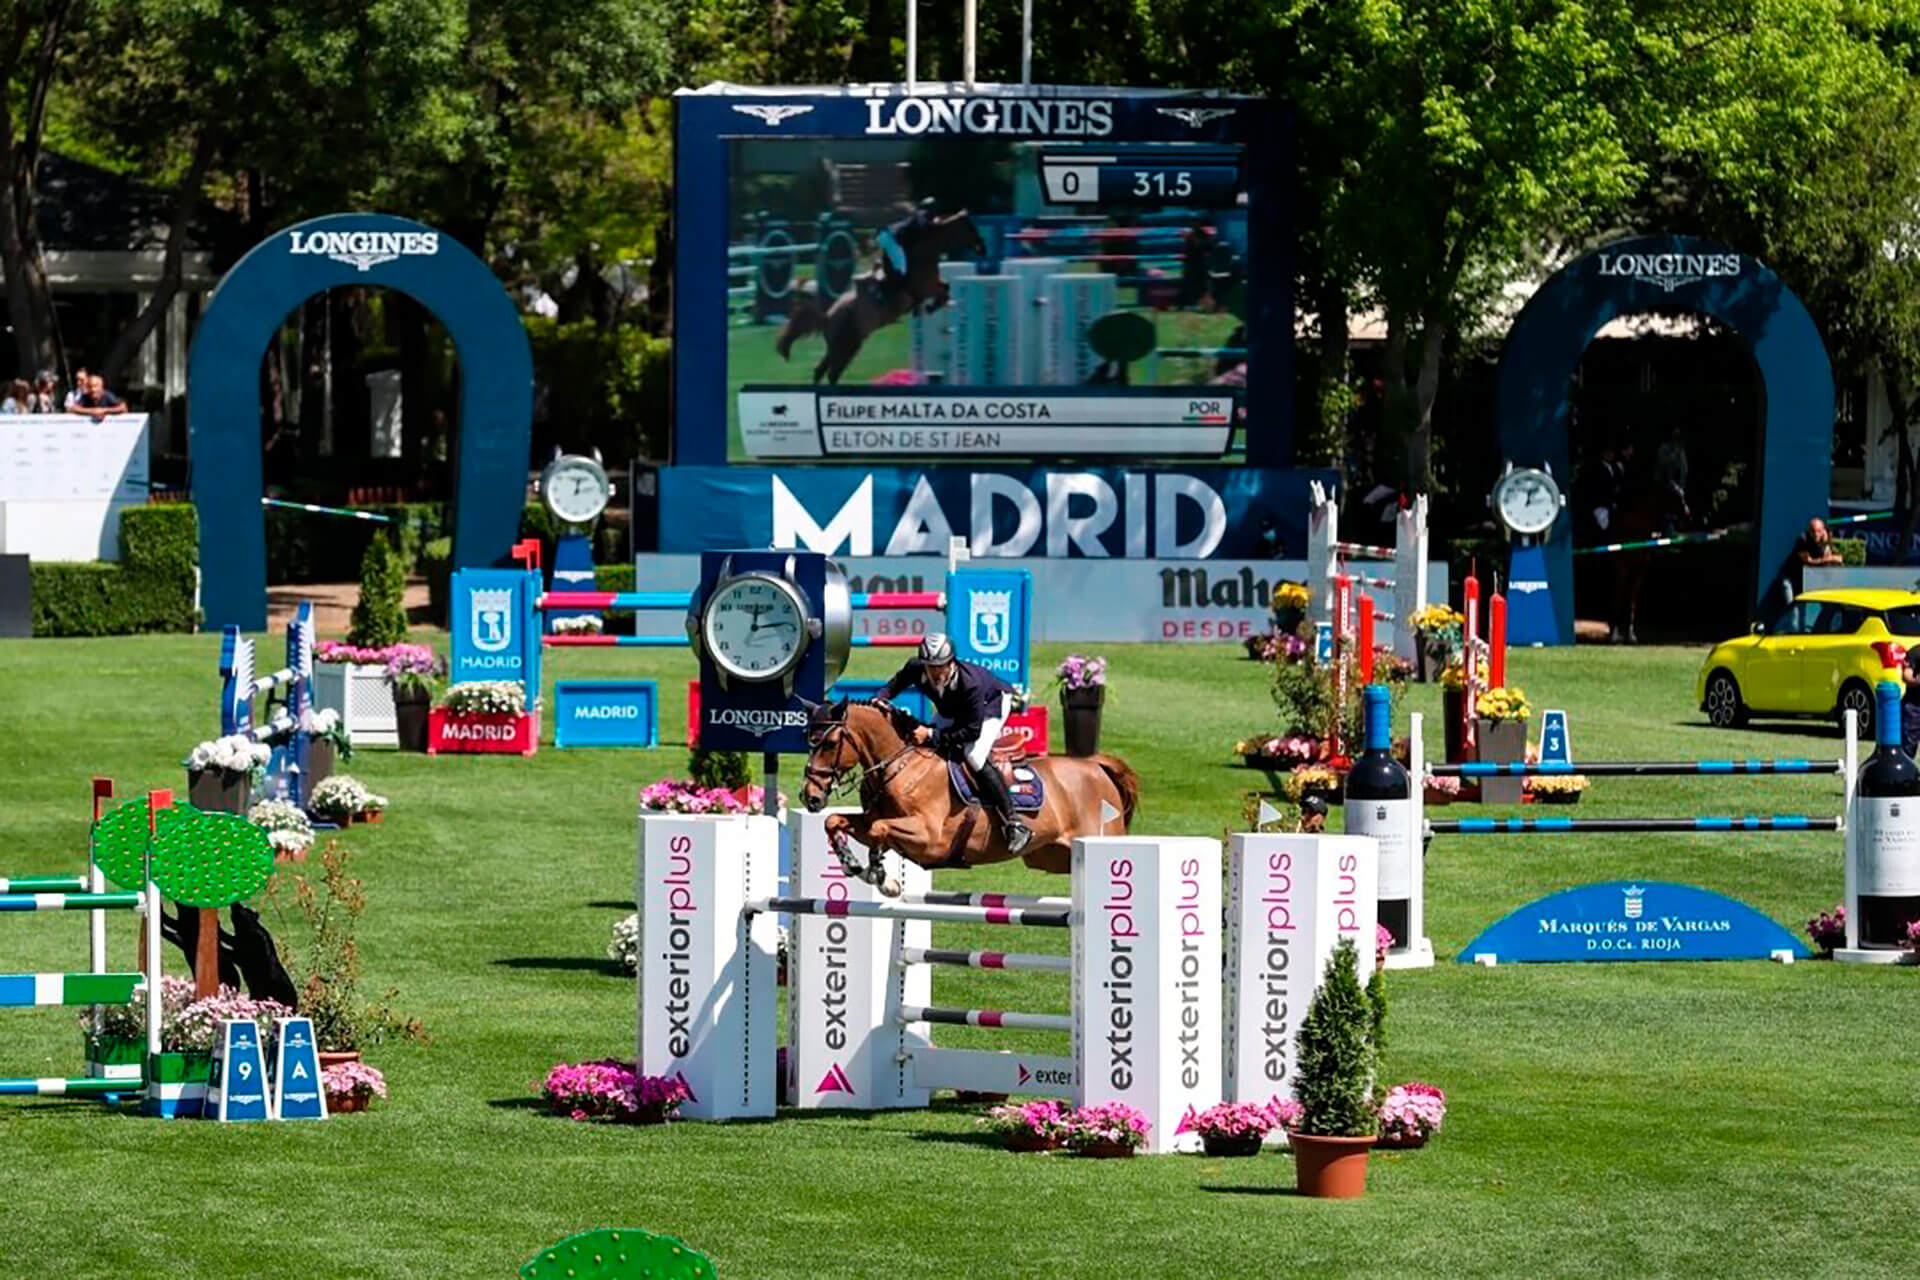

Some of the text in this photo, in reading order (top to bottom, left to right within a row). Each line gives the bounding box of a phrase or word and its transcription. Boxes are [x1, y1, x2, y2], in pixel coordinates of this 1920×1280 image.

[864, 98, 1113, 135] LONGINES
[1062, 171, 1080, 195] 0
[1132, 171, 1192, 197] 31.5
[289, 231, 439, 255] LONGINES
[1598, 253, 1741, 276] LONGINES
[880, 402, 946, 419] MALTA
[951, 402, 980, 419] DA
[984, 402, 1051, 419] COSTA
[1188, 400, 1221, 415] POR
[832, 431, 894, 448] ELTON
[899, 431, 925, 448] DE
[929, 431, 949, 448] ST
[953, 431, 1001, 448] JEAN
[771, 472, 1227, 558] MADRID
[862, 617, 925, 635] 1890
[1162, 620, 1251, 638] DESDE
[460, 656, 522, 670] MADRID
[574, 705, 639, 719] MADRID
[709, 708, 808, 726] LONGINES
[441, 723, 516, 741] MADRID
[1549, 737, 1560, 751] 3
[1635, 920, 1659, 933] DE
[662, 835, 697, 1059] exteriorplus
[1641, 938, 1681, 951] RIOJA
[1103, 858, 1140, 1091] exteriorplus
[1175, 858, 1205, 1090] exteriorplus
[1259, 852, 1296, 1082] exteriorplus
[238, 1062, 253, 1080] 9
[291, 1061, 309, 1080] A
